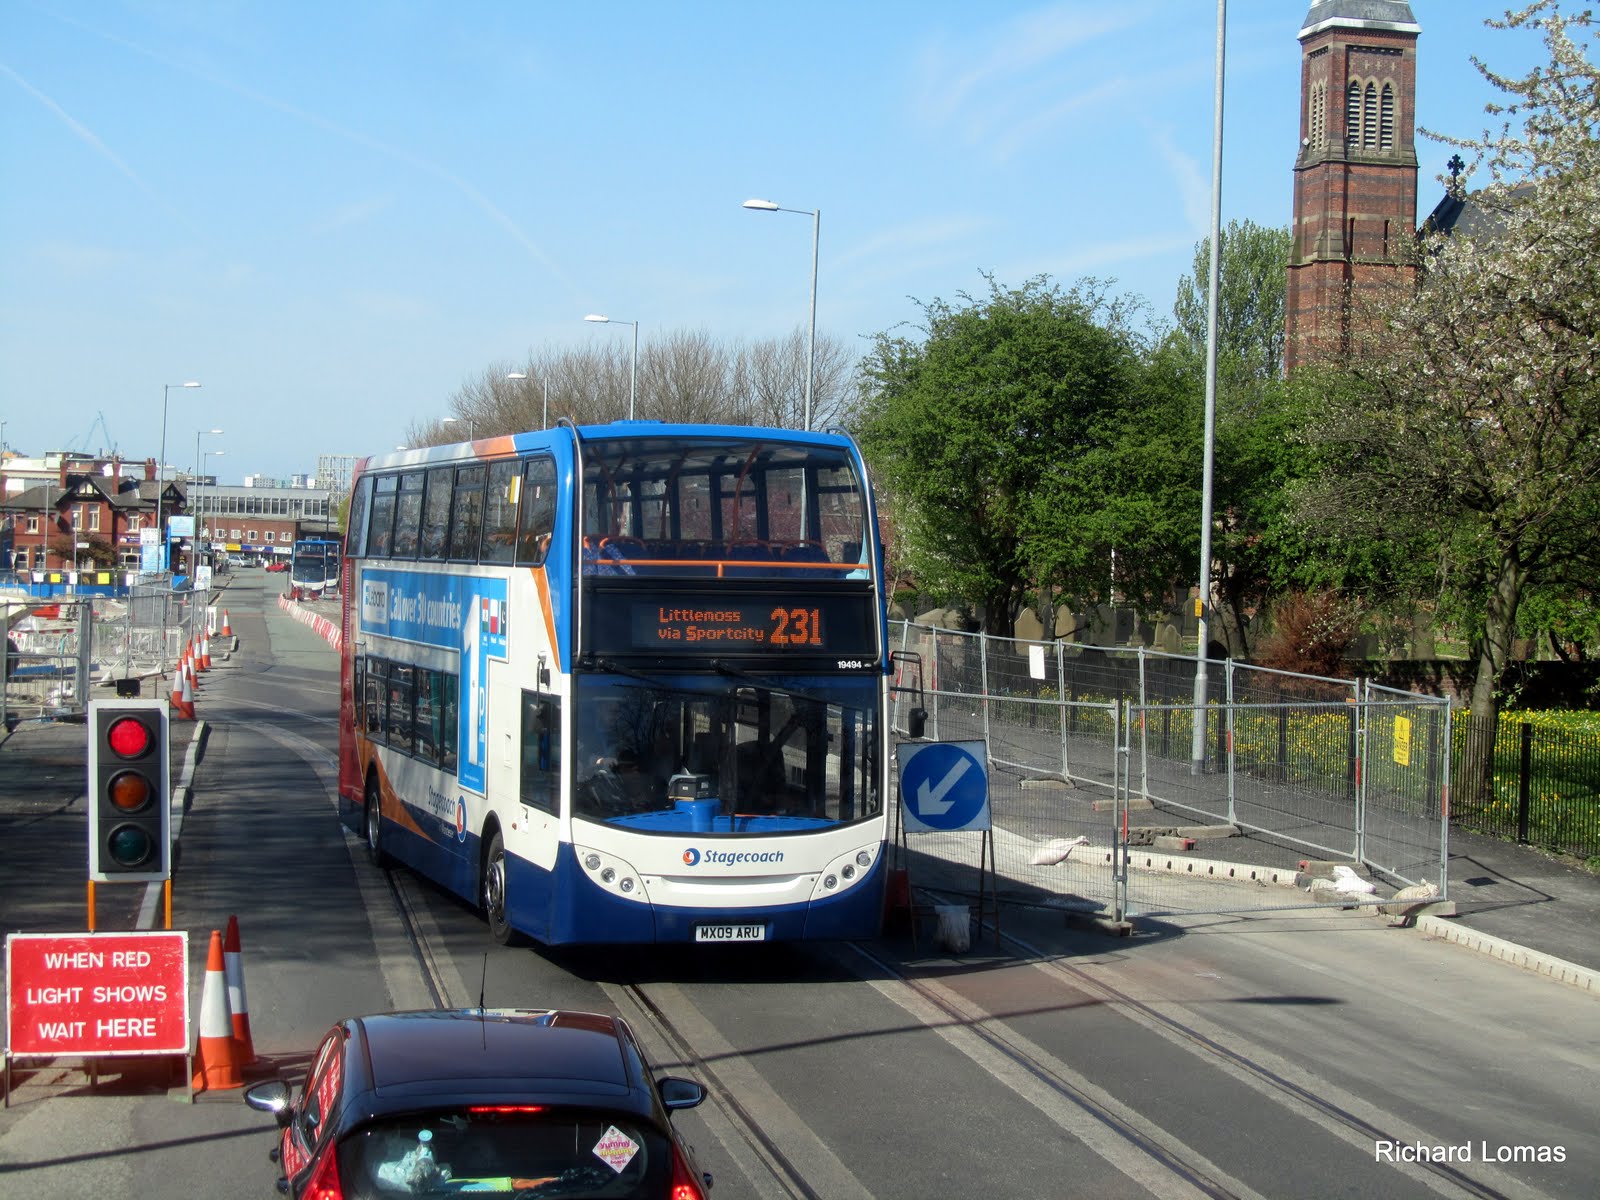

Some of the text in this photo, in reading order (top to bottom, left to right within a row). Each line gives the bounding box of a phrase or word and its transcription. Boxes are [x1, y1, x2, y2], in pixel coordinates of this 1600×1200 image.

[390, 588, 461, 630] Call over 30 countries
[658, 625, 765, 642] via Sportcity
[659, 607, 822, 644] Littlemoss 231
[837, 660, 862, 669] 19494
[428, 784, 456, 817] Stagecoach
[703, 849, 785, 867] Stagecoach
[700, 926, 760, 940] MX09 ARU
[45, 951, 151, 969] WHEN RED
[27, 985, 167, 1004] LIGHT SHOWS
[38, 1018, 157, 1039] WAIT HERE
